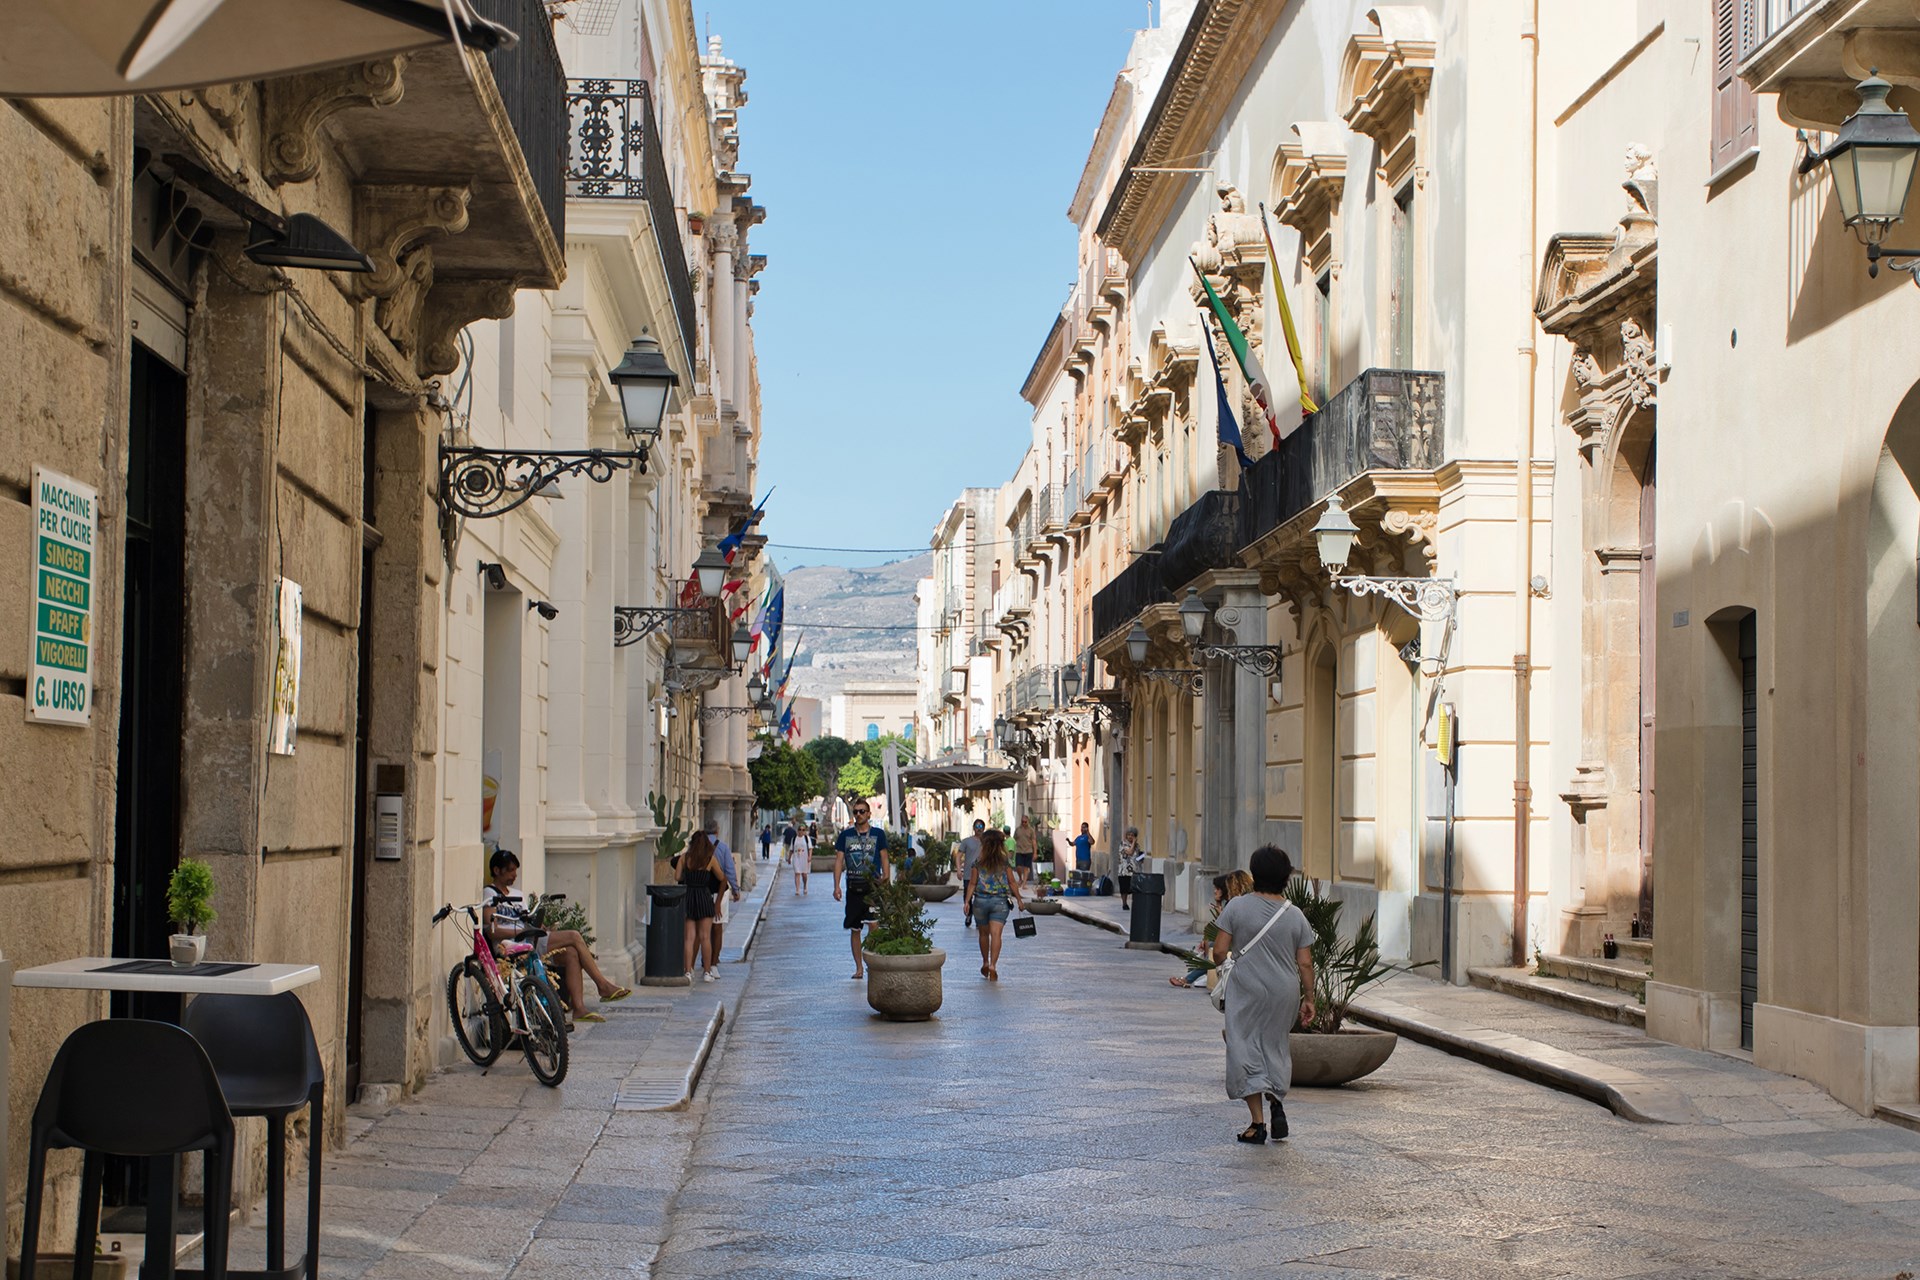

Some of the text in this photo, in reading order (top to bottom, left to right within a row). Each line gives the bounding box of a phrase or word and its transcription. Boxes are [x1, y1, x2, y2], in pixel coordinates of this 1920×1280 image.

[41, 482, 90, 519] MACCHINE
[40, 508, 91, 545] PER CUCIRE
[46, 543, 84, 573] SINGER
[46, 576, 84, 605] NECCHI
[49, 610, 79, 635] PFAFF
[40, 640, 85, 668] VIGORELLI
[36, 676, 86, 712] G. URSO
